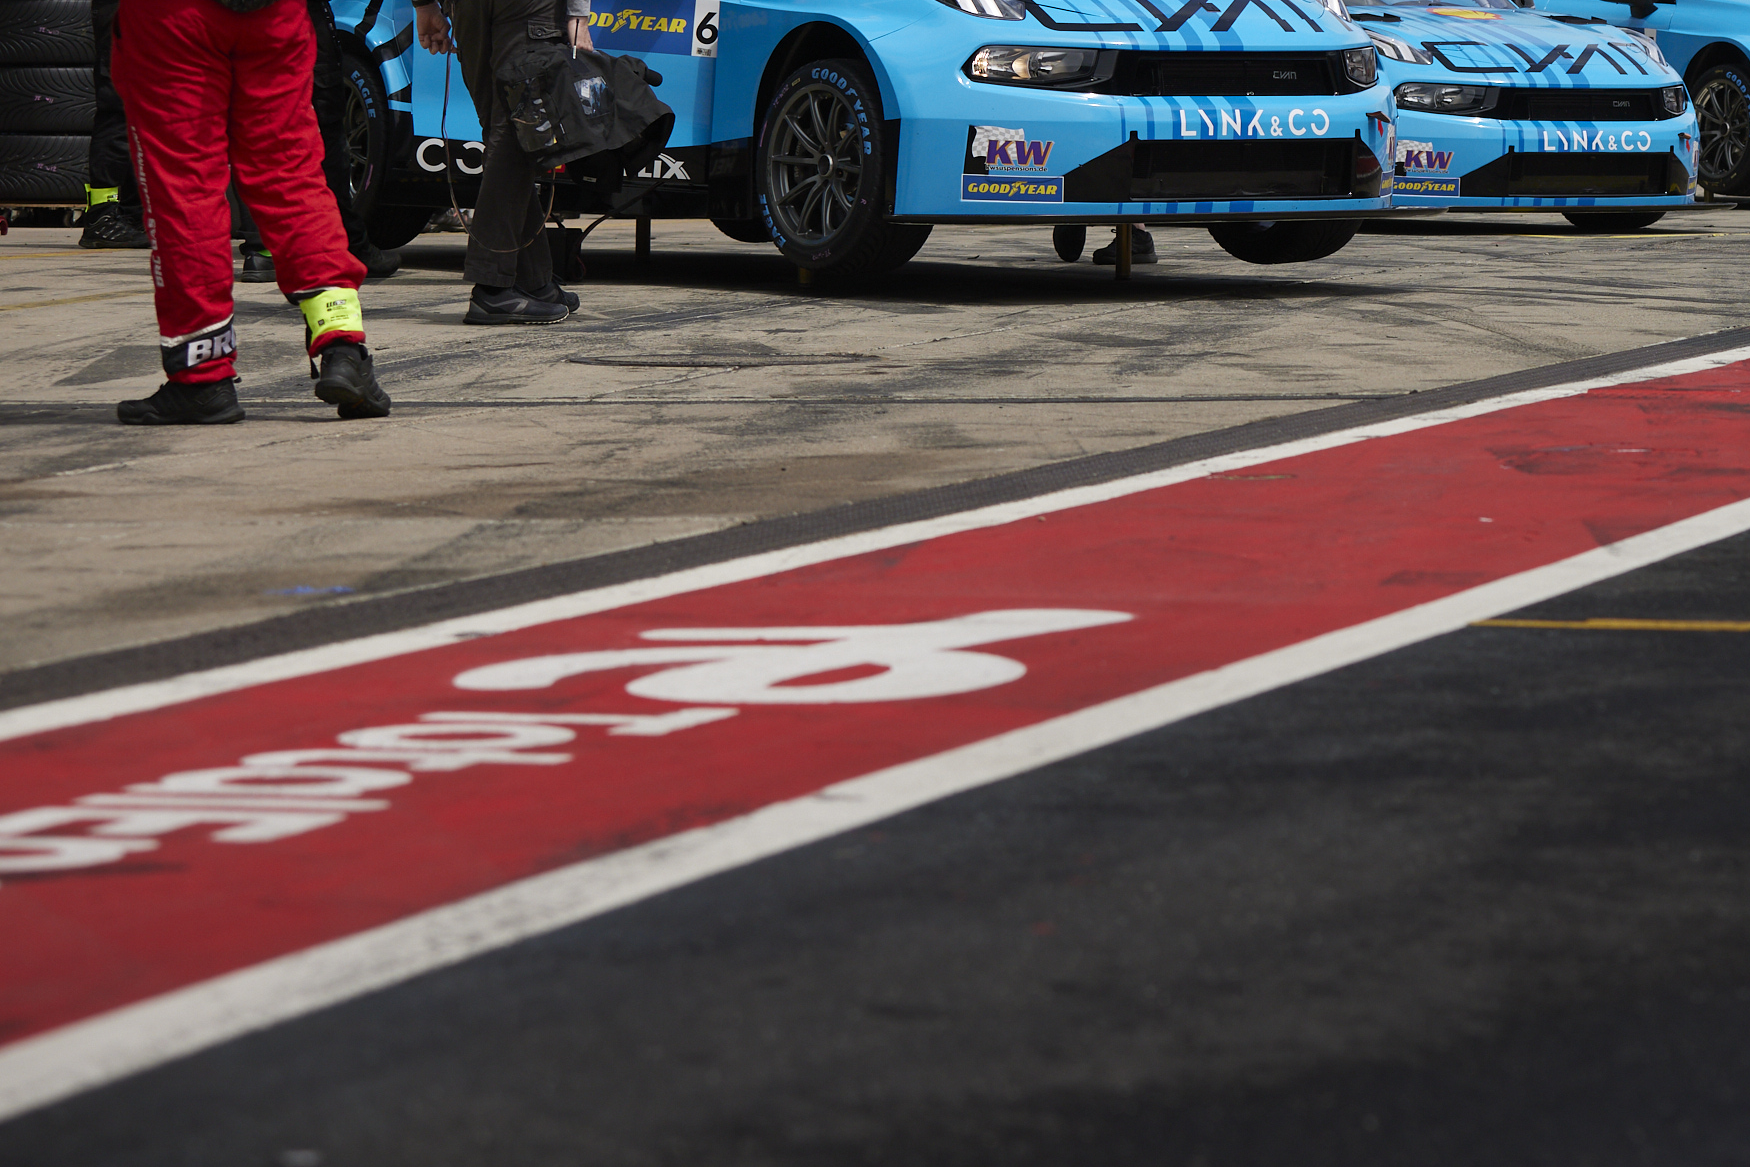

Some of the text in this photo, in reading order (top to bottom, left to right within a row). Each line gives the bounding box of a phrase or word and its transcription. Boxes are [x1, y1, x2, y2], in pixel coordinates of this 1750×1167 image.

[351, 69, 376, 119] EAGLE
[811, 67, 873, 156] GOODYEAR
[1180, 108, 1331, 138] LYNK&CO
[986, 139, 1055, 167] KW
[1543, 130, 1651, 152] LYNK&CO
[985, 163, 1049, 173] kwsuspensions.de
[1404, 149, 1454, 170] KW
[967, 179, 1058, 197] GOODYEAR
[1393, 180, 1456, 193] GOODYEAR
[759, 194, 786, 248] EAGLE
